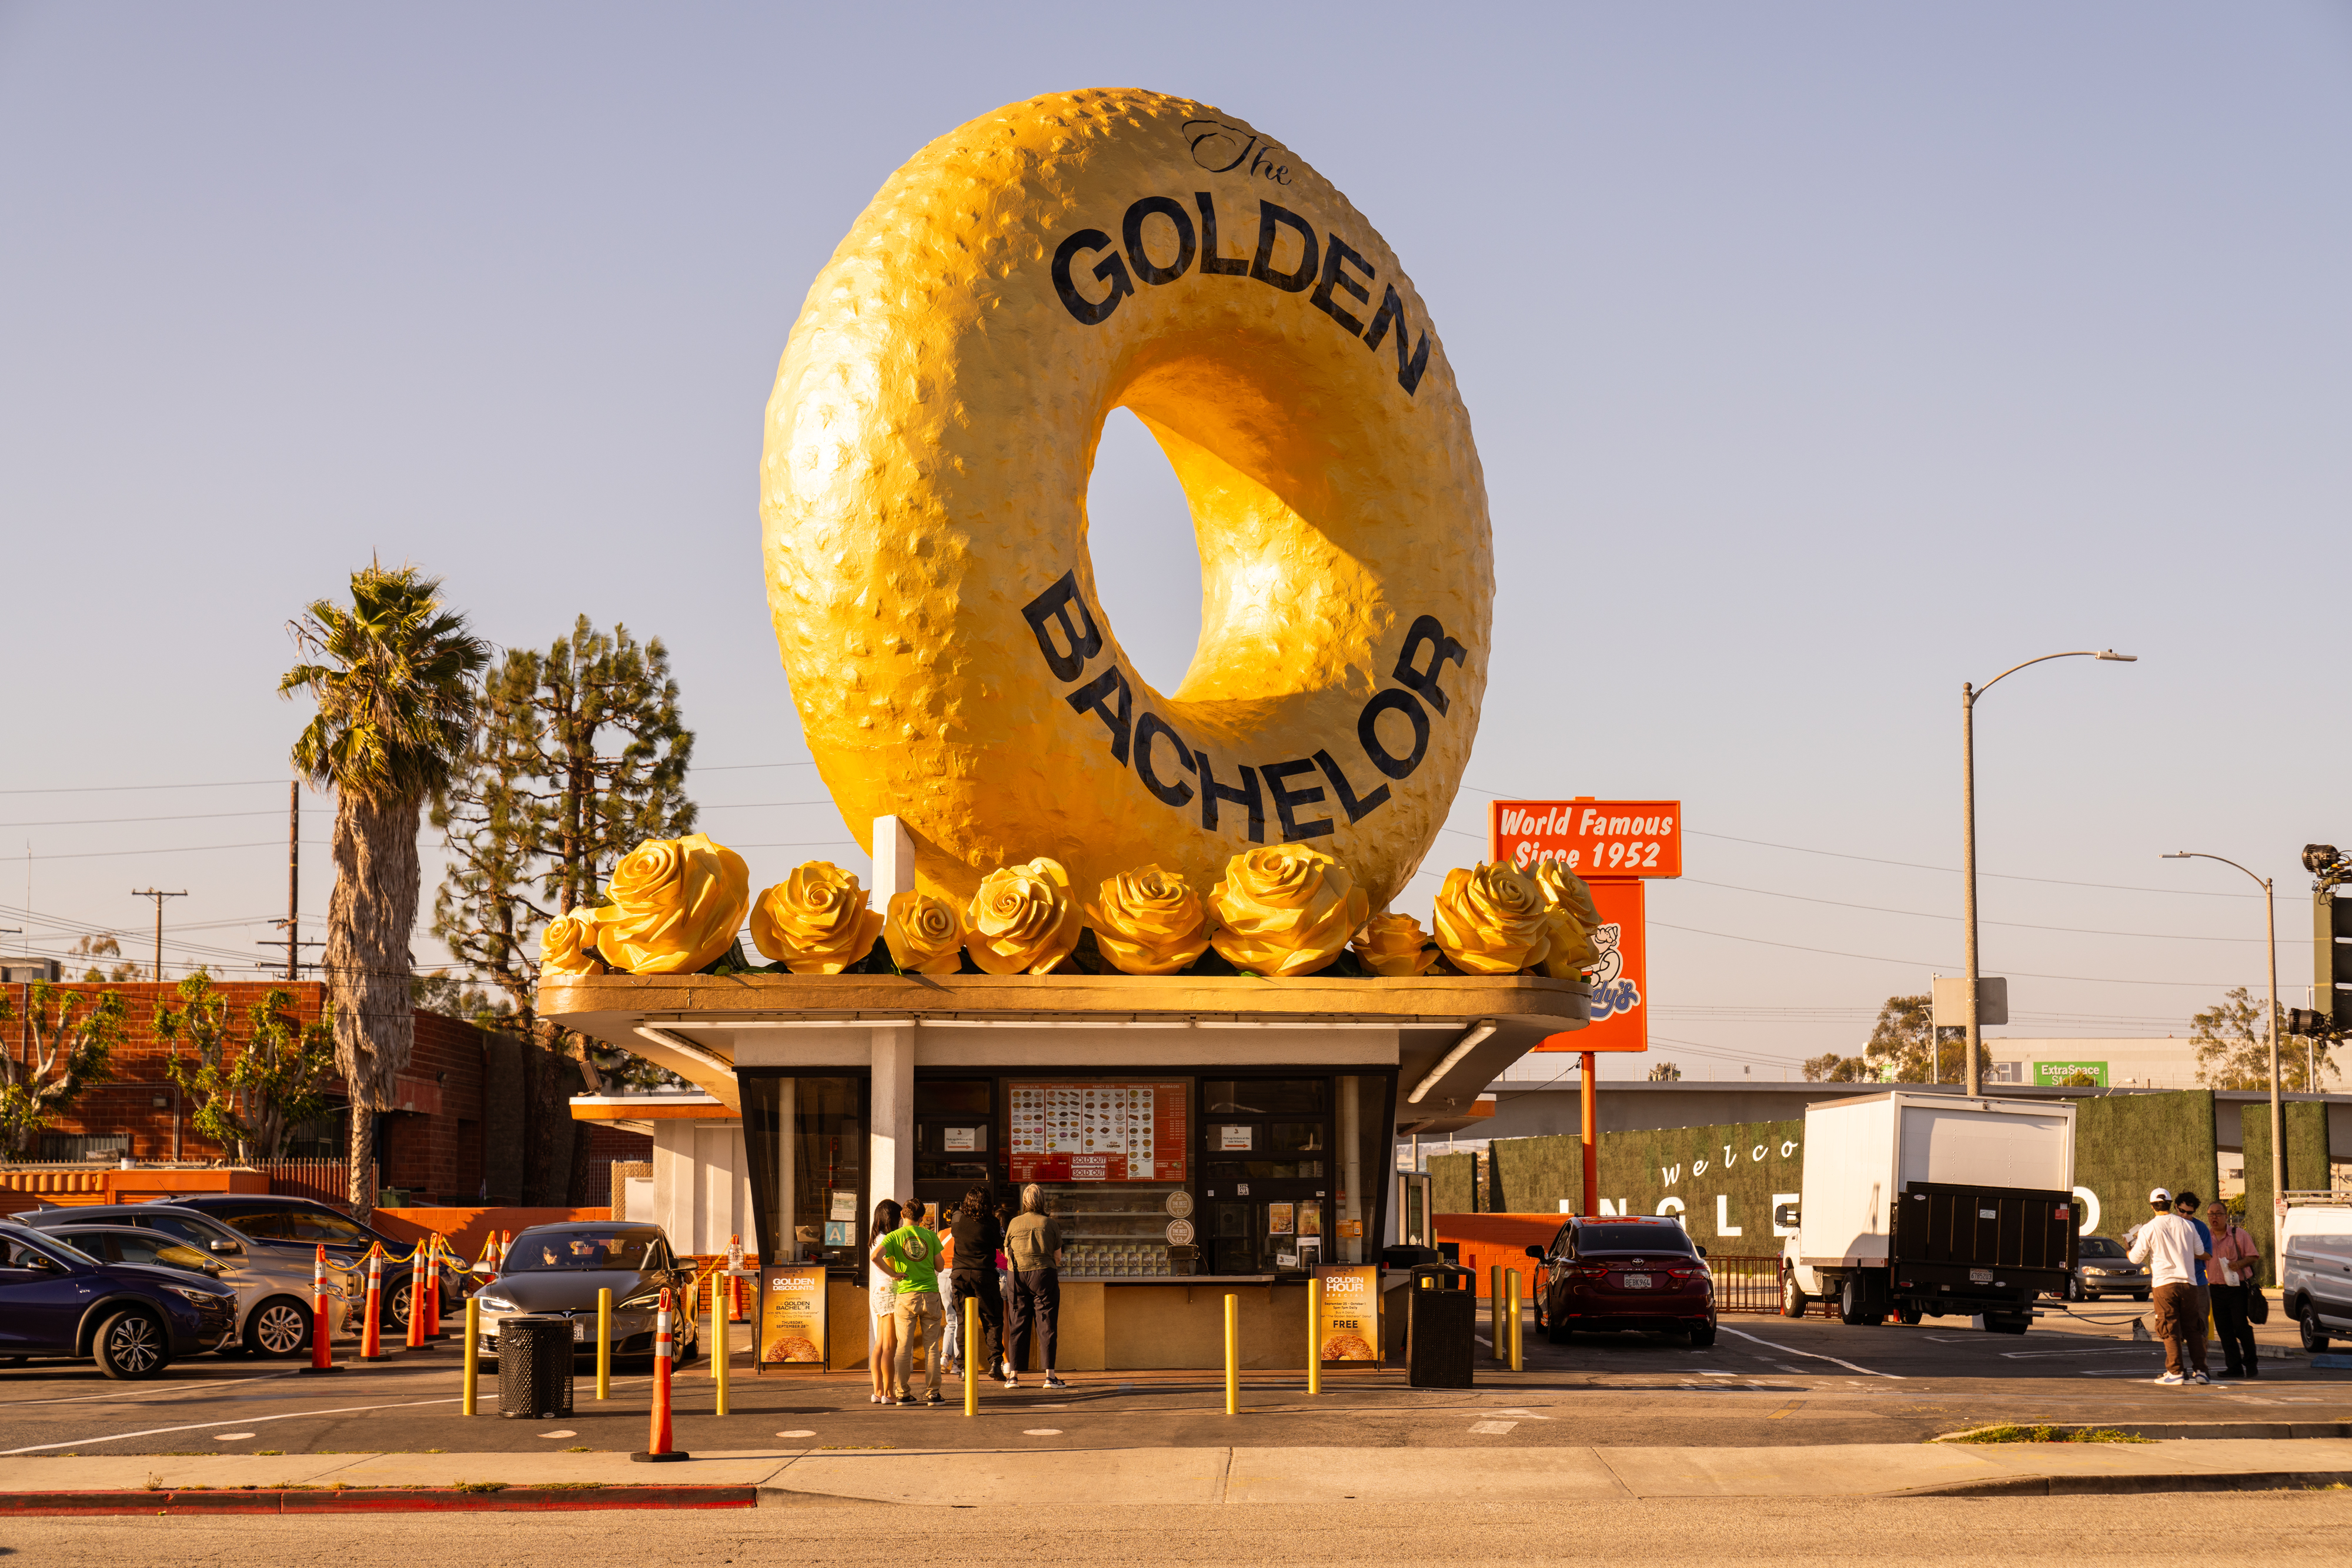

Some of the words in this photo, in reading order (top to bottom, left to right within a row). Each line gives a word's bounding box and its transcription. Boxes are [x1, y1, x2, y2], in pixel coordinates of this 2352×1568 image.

[1182, 119, 1292, 186] The
[1051, 191, 1431, 397] GOLDEN
[1021, 569, 1468, 844] BACHELOR
[1500, 807, 1572, 836] World
[1579, 808, 1673, 836] Famous
[1516, 841, 1580, 868] Since
[1593, 842, 1661, 868] 1952
[2042, 1065, 2100, 1075] ExtraSpace
[1662, 1140, 1798, 1187] welco
[829, 1227, 841, 1241] A
[1327, 1283, 1363, 1292] HOUR
